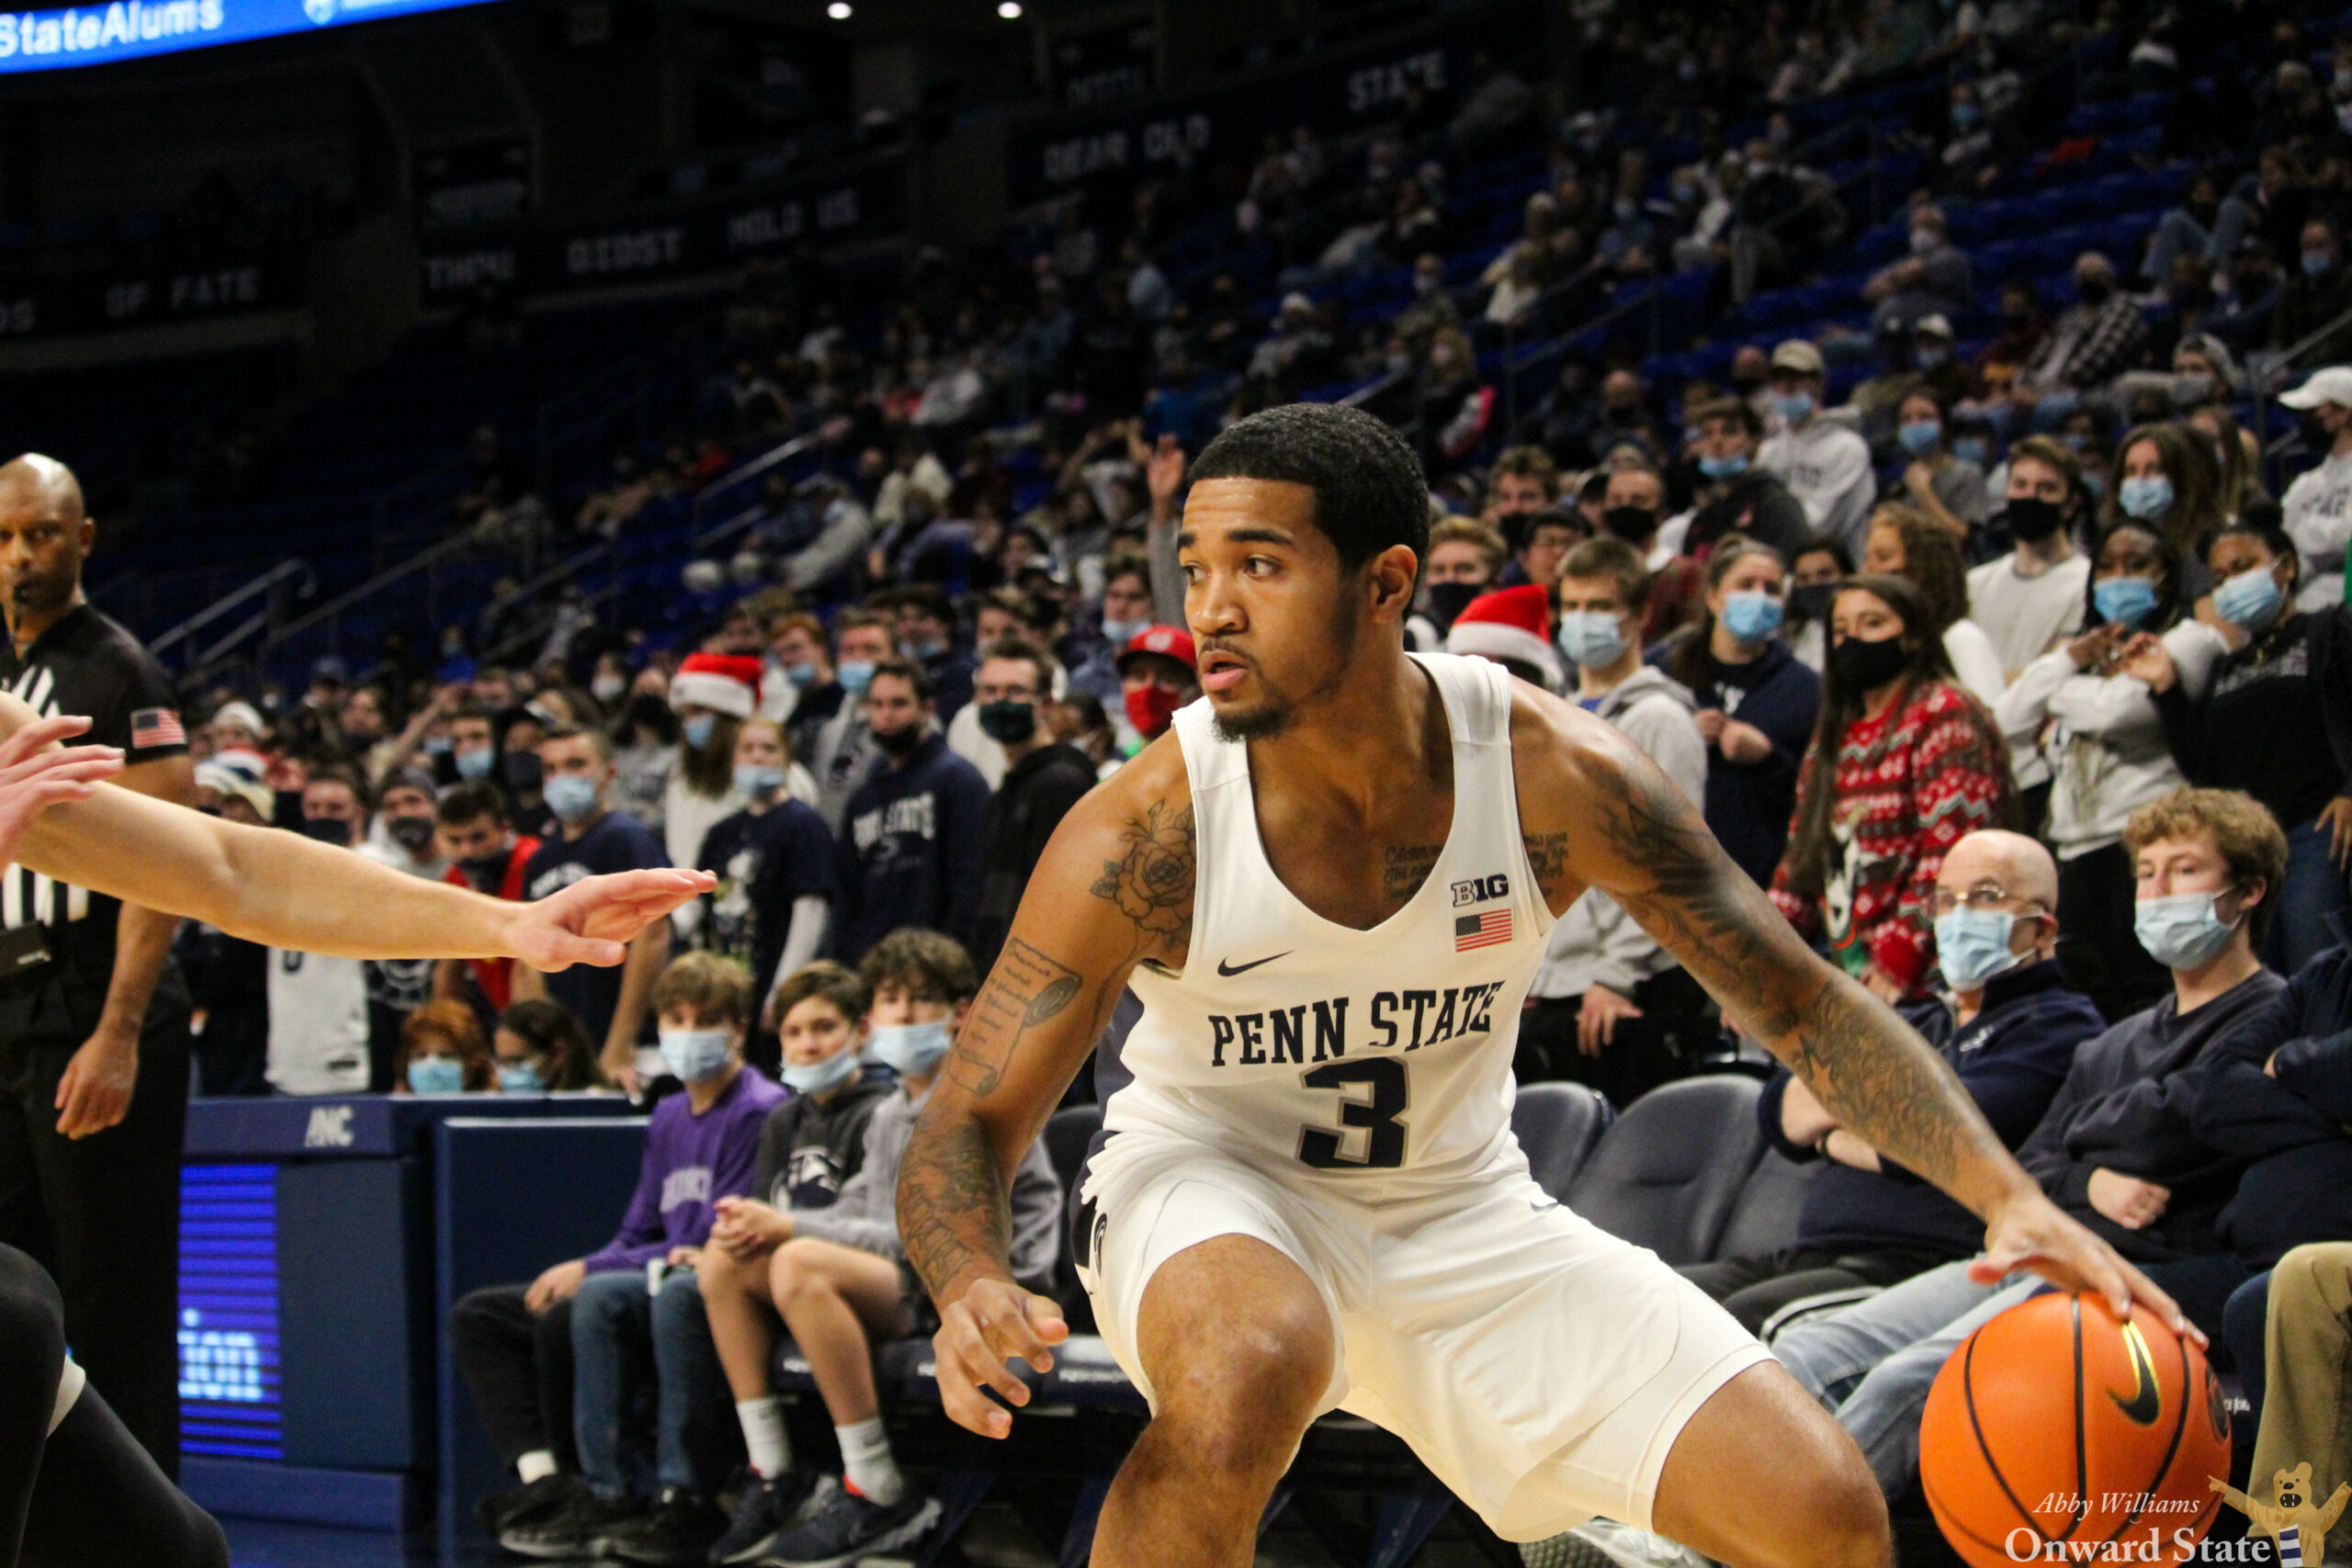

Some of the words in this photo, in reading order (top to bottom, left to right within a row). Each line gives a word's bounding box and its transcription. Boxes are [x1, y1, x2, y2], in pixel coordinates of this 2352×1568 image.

[171, 267, 257, 307] FATE
[1208, 997, 1350, 1067] PENN
[1367, 979, 1506, 1053] STATE
[1295, 1055, 1411, 1169] 3
